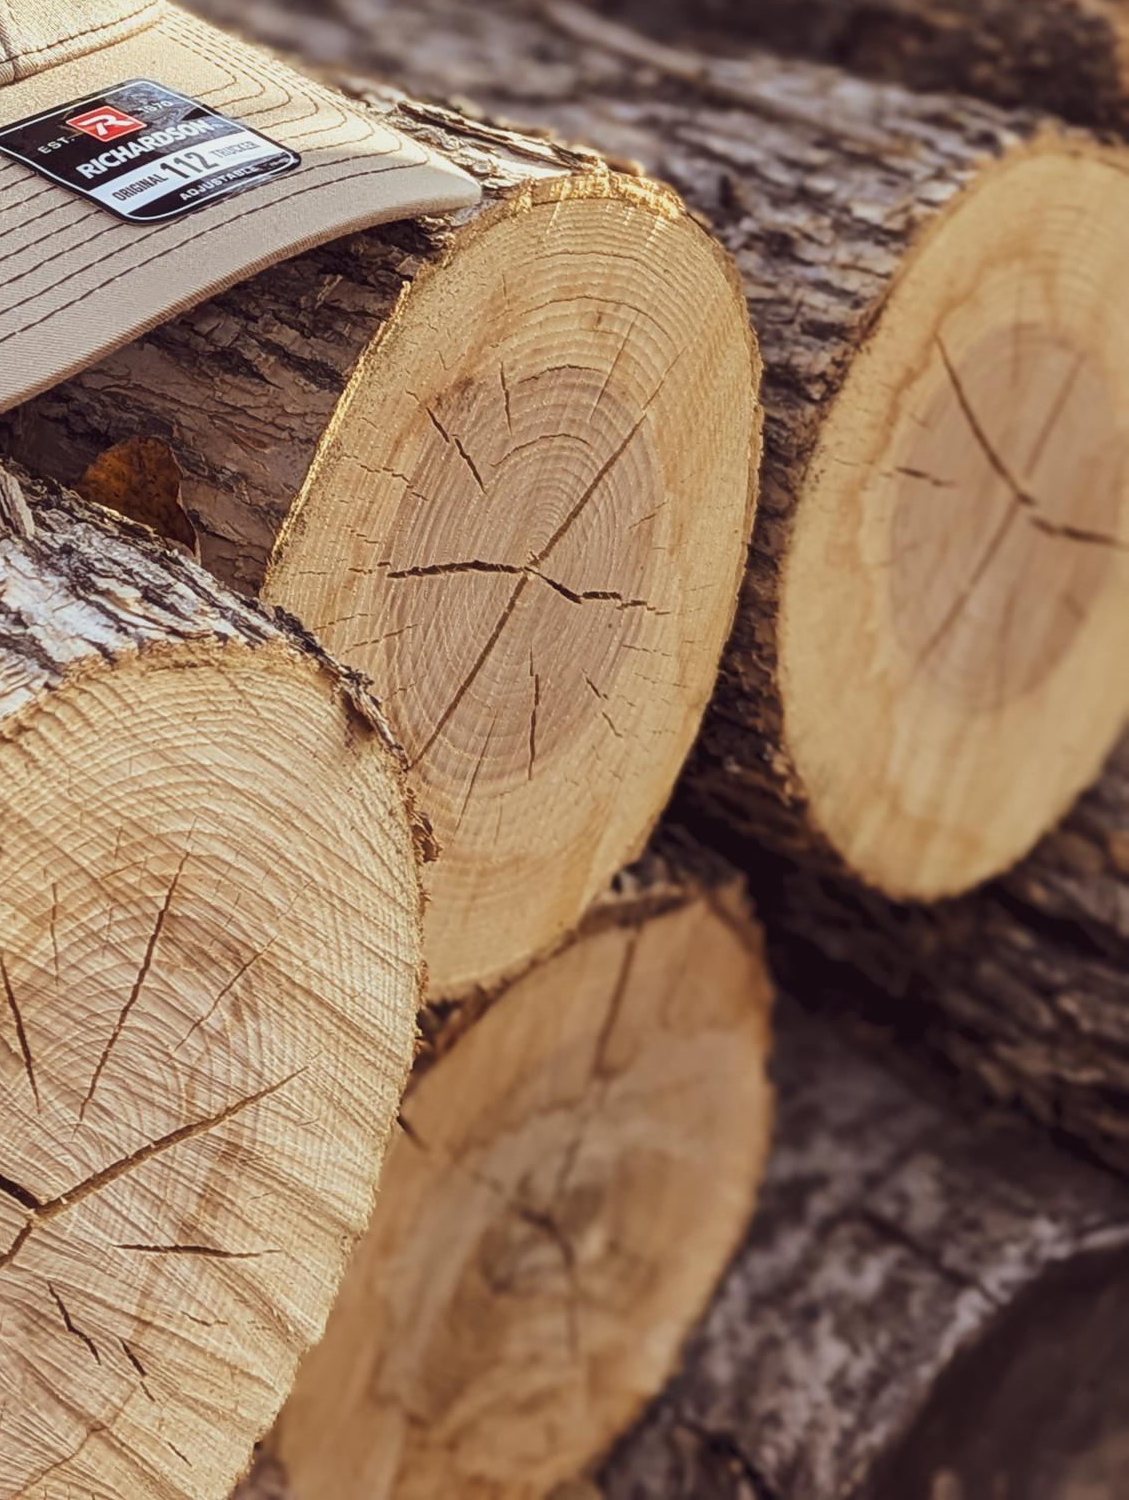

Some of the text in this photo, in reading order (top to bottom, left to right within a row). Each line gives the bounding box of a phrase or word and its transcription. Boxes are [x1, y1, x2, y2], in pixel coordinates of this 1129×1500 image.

[37, 135, 76, 155] EST.
[75, 119, 215, 180] RICHARDSON
[111, 173, 170, 202] ORIGINAL
[159, 151, 220, 180] 112
[179, 164, 259, 201] ADJUSTABLE
